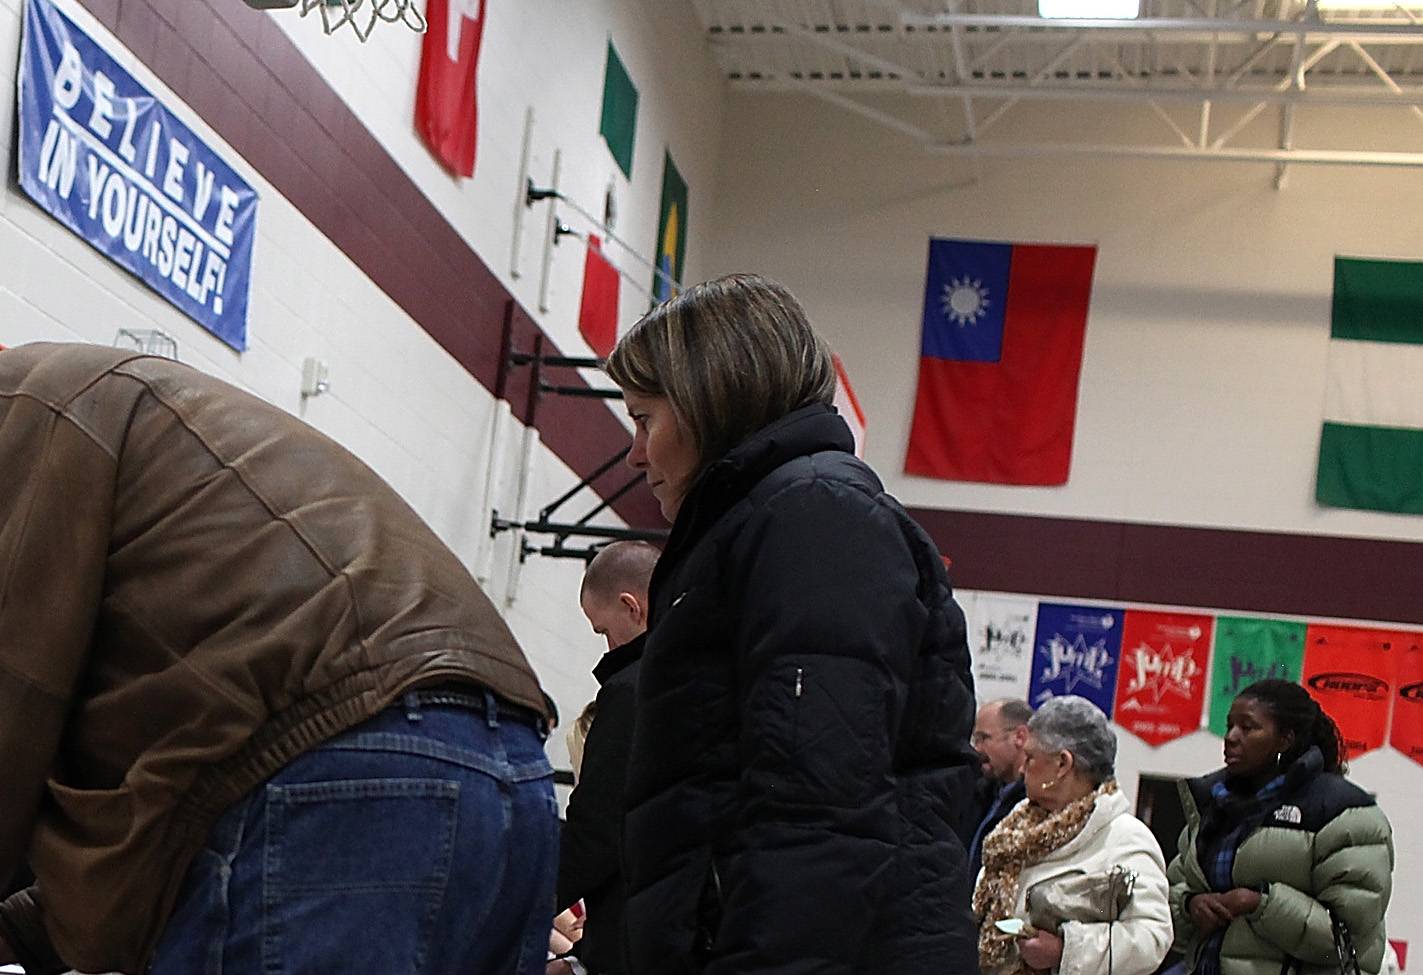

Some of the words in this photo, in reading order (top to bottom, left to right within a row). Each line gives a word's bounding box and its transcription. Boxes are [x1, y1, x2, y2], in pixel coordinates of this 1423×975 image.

[38, 119, 76, 200] IN
[87, 153, 227, 315] YOURSELF!
[53, 39, 239, 246] BELIEVE
